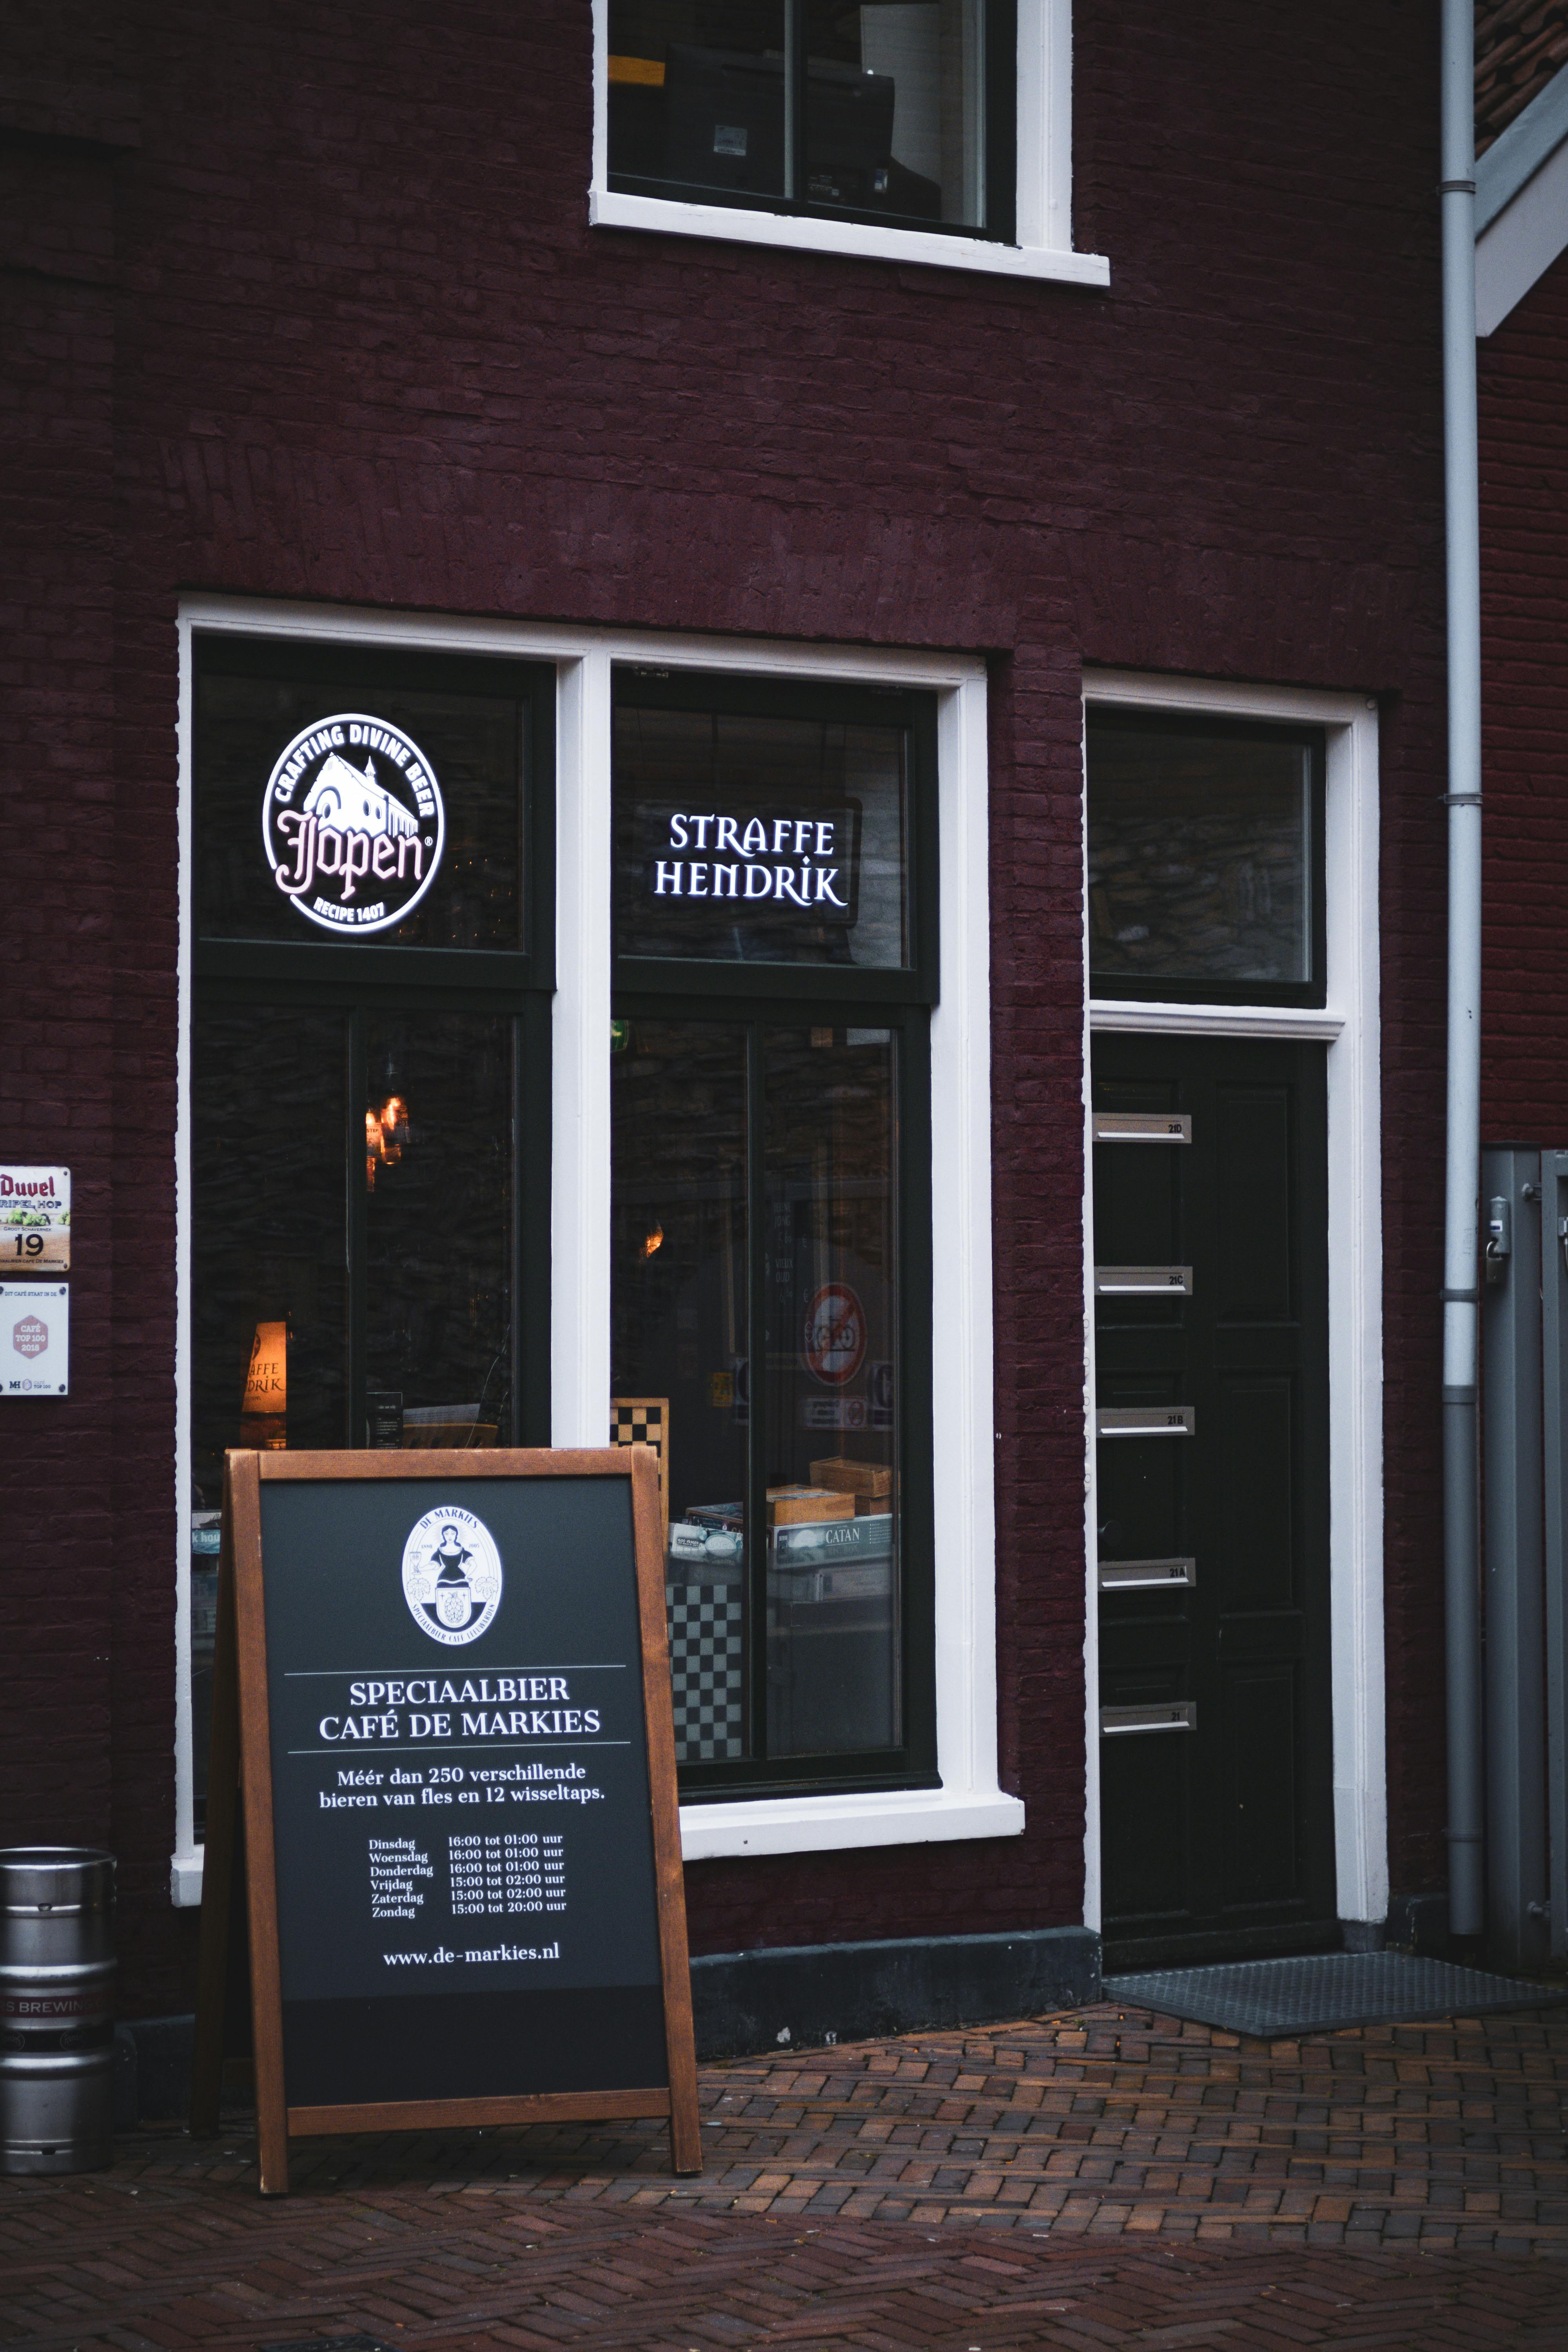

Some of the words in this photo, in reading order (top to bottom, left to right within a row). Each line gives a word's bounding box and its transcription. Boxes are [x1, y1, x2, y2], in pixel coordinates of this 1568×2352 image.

[275, 726, 345, 802] CRAFTING
[350, 724, 410, 767] DIVINE
[405, 762, 434, 817] BEER
[670, 814, 834, 857] STRAFFE
[654, 856, 848, 906] HENDRIK
[313, 897, 354, 921] RECIPE
[357, 902, 384, 921] 1407
[1169, 1124, 1182, 1133] 21D
[0, 1174, 55, 1197] Duvel
[15, 1234, 44, 1256] 19
[776, 1271, 790, 1282] OUD
[1169, 1276, 1183, 1285] 21C
[21, 1323, 40, 1332] CAFÉ
[249, 1363, 279, 1376] AFFE
[419, 1516, 434, 1529] DE
[435, 1508, 479, 1529] MARKIES
[826, 1528, 860, 1544] CATAN
[412, 1604, 446, 1641] SPECIAALBIER
[468, 1604, 495, 1639] LEEUWARDEN
[350, 1677, 570, 1706] SPECIAALBIER
[319, 1710, 399, 1740] CAFÉ
[409, 1713, 451, 1737] DE
[462, 1710, 600, 1735] MARKIES
[1171, 1712, 1180, 1721] 21
[338, 1770, 383, 1786] Méér
[390, 1768, 423, 1784] dan
[428, 1767, 463, 1783] 250
[469, 1763, 586, 1782] verschillende
[319, 1792, 377, 1808] bieren
[383, 1792, 415, 1806] van
[421, 1788, 452, 1804] fles
[458, 1790, 480, 1803] en
[486, 1787, 505, 1802] 12
[510, 1784, 605, 1804] wisseltaps.
[369, 1838, 416, 1851] Dinsdag
[448, 1836, 481, 1846] 16:00
[485, 1836, 501, 1846] tot
[504, 1834, 538, 1844] 01:00
[543, 1835, 563, 1844] uur
[369, 1851, 428, 1864] Woensdag
[449, 1849, 481, 1860] 16:00
[486, 1849, 501, 1859] tot
[505, 1847, 539, 1858] 01:00
[543, 1848, 564, 1857] uur
[370, 1865, 434, 1877] Donderdag
[450, 1863, 482, 1874] 16:00
[486, 1863, 502, 1872] tot
[506, 1861, 539, 1872] 01:00
[544, 1861, 564, 1870] uur
[370, 1878, 413, 1893] Vrijdag
[450, 1876, 483, 1887] 15:00
[486, 1877, 502, 1886] tot
[506, 1874, 541, 1885] 02:00
[545, 1875, 565, 1884] uur
[372, 1892, 424, 1905] Zaterdag
[451, 1889, 484, 1901] 15:00
[487, 1890, 503, 1899] tot
[506, 1888, 542, 1899] 02:00
[546, 1888, 566, 1897] uur
[372, 1906, 415, 1919] Zondag
[452, 1903, 485, 1914] 15:00
[488, 1904, 504, 1913] tot
[507, 1901, 543, 1912] 20:00
[546, 1902, 567, 1911] uur
[383, 1942, 560, 1965] www.de-markies.nl
